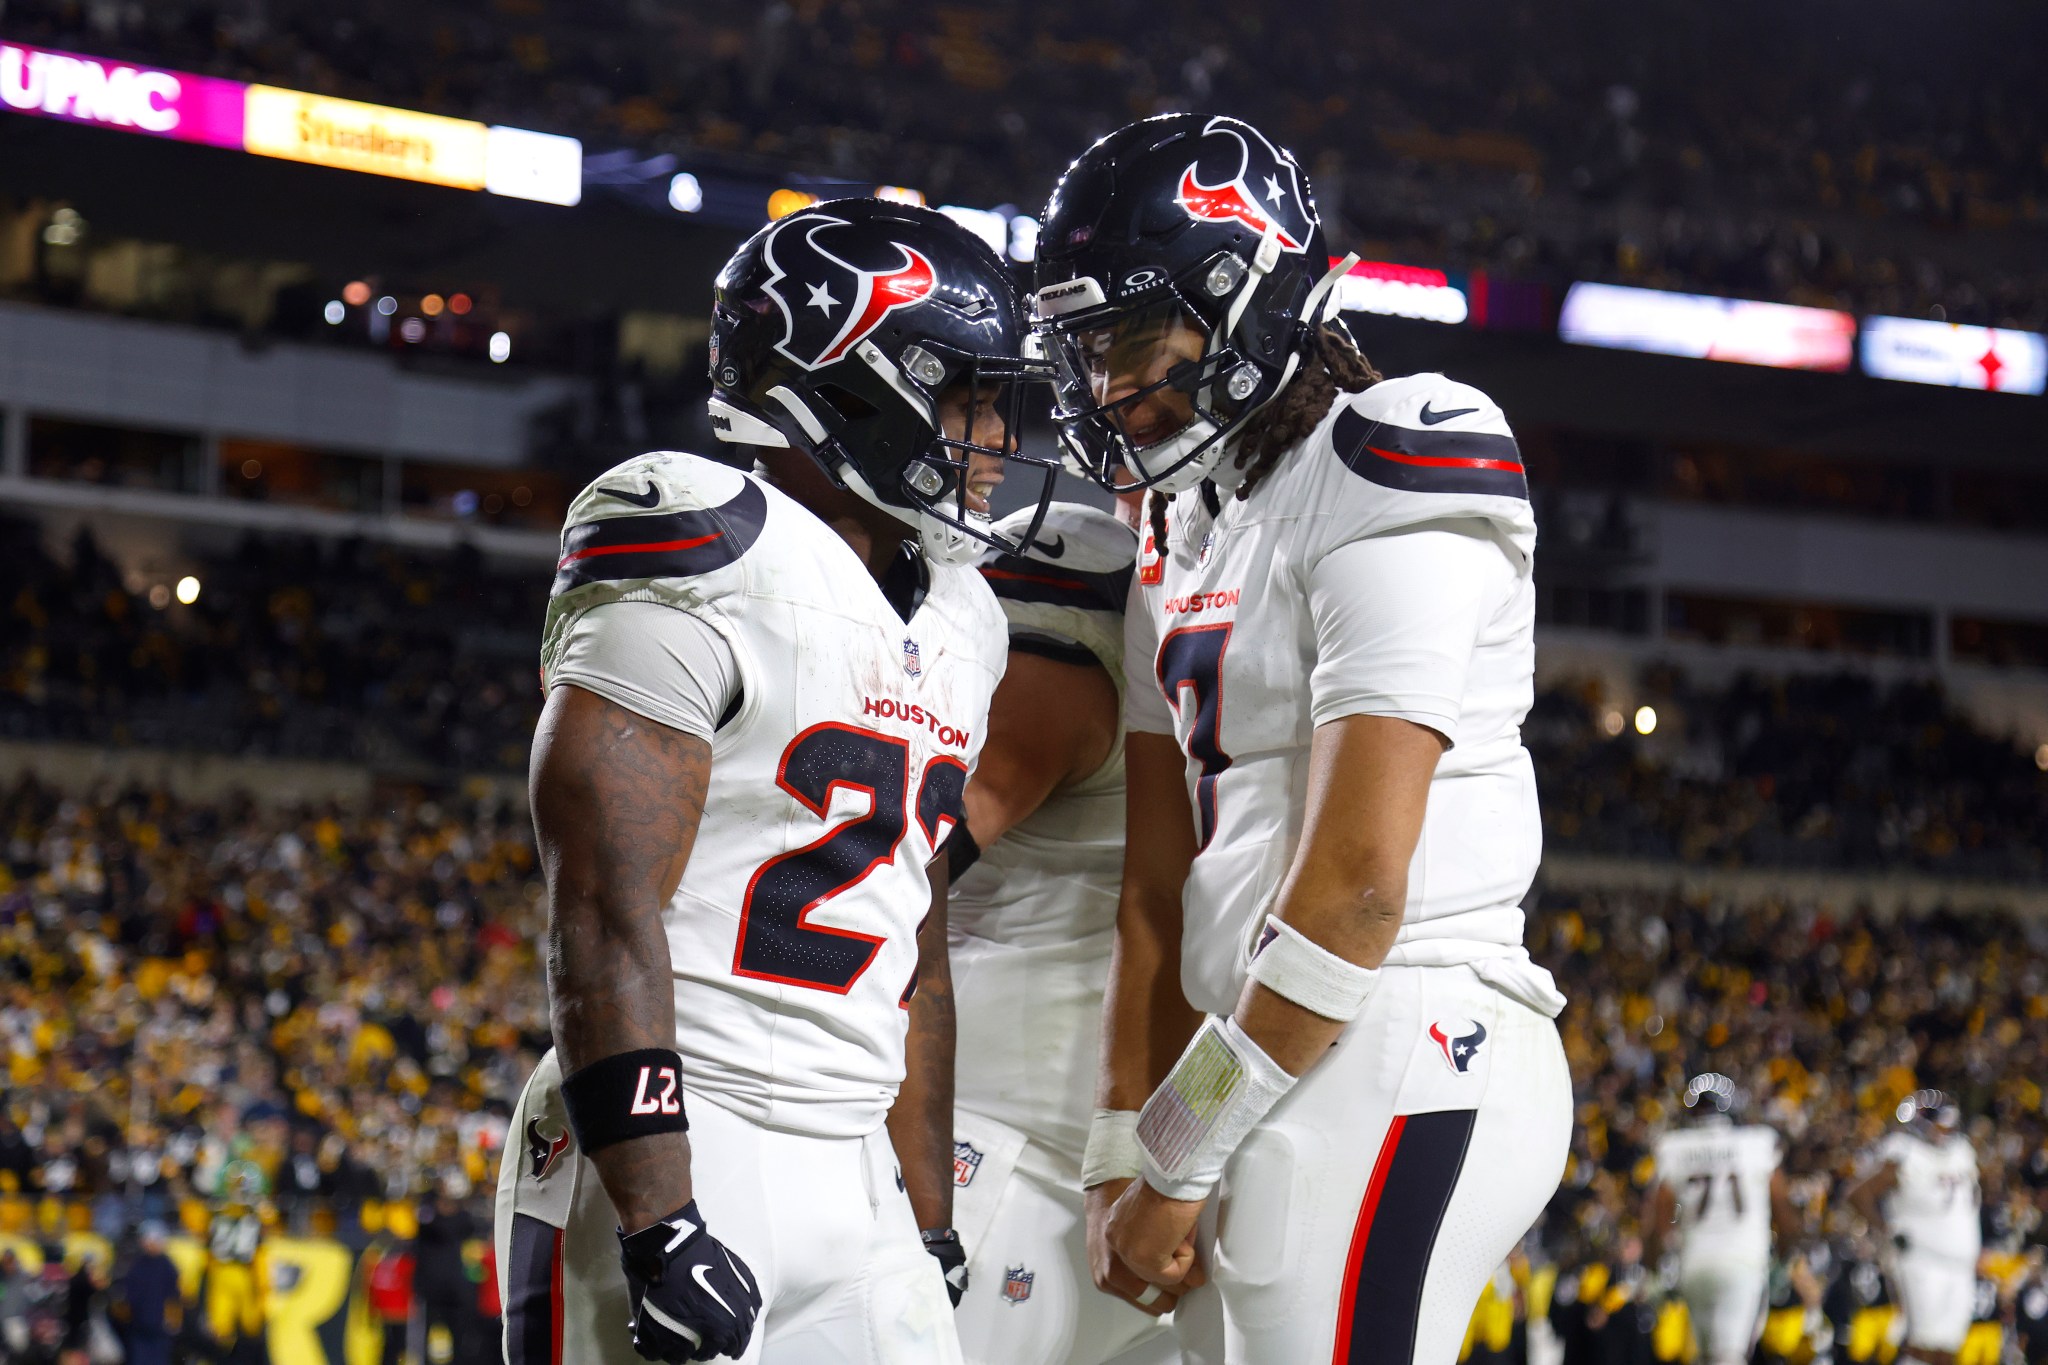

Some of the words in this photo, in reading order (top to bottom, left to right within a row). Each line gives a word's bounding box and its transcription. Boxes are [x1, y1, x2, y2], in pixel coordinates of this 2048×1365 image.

[1040, 283, 1087, 301] TEXANS
[1121, 278, 1165, 297] OAKLEY
[1164, 588, 1241, 614] HOUSTON
[863, 696, 970, 749] HOUSTON
[1154, 621, 1233, 857] 7
[1687, 1172, 1743, 1216] 71
